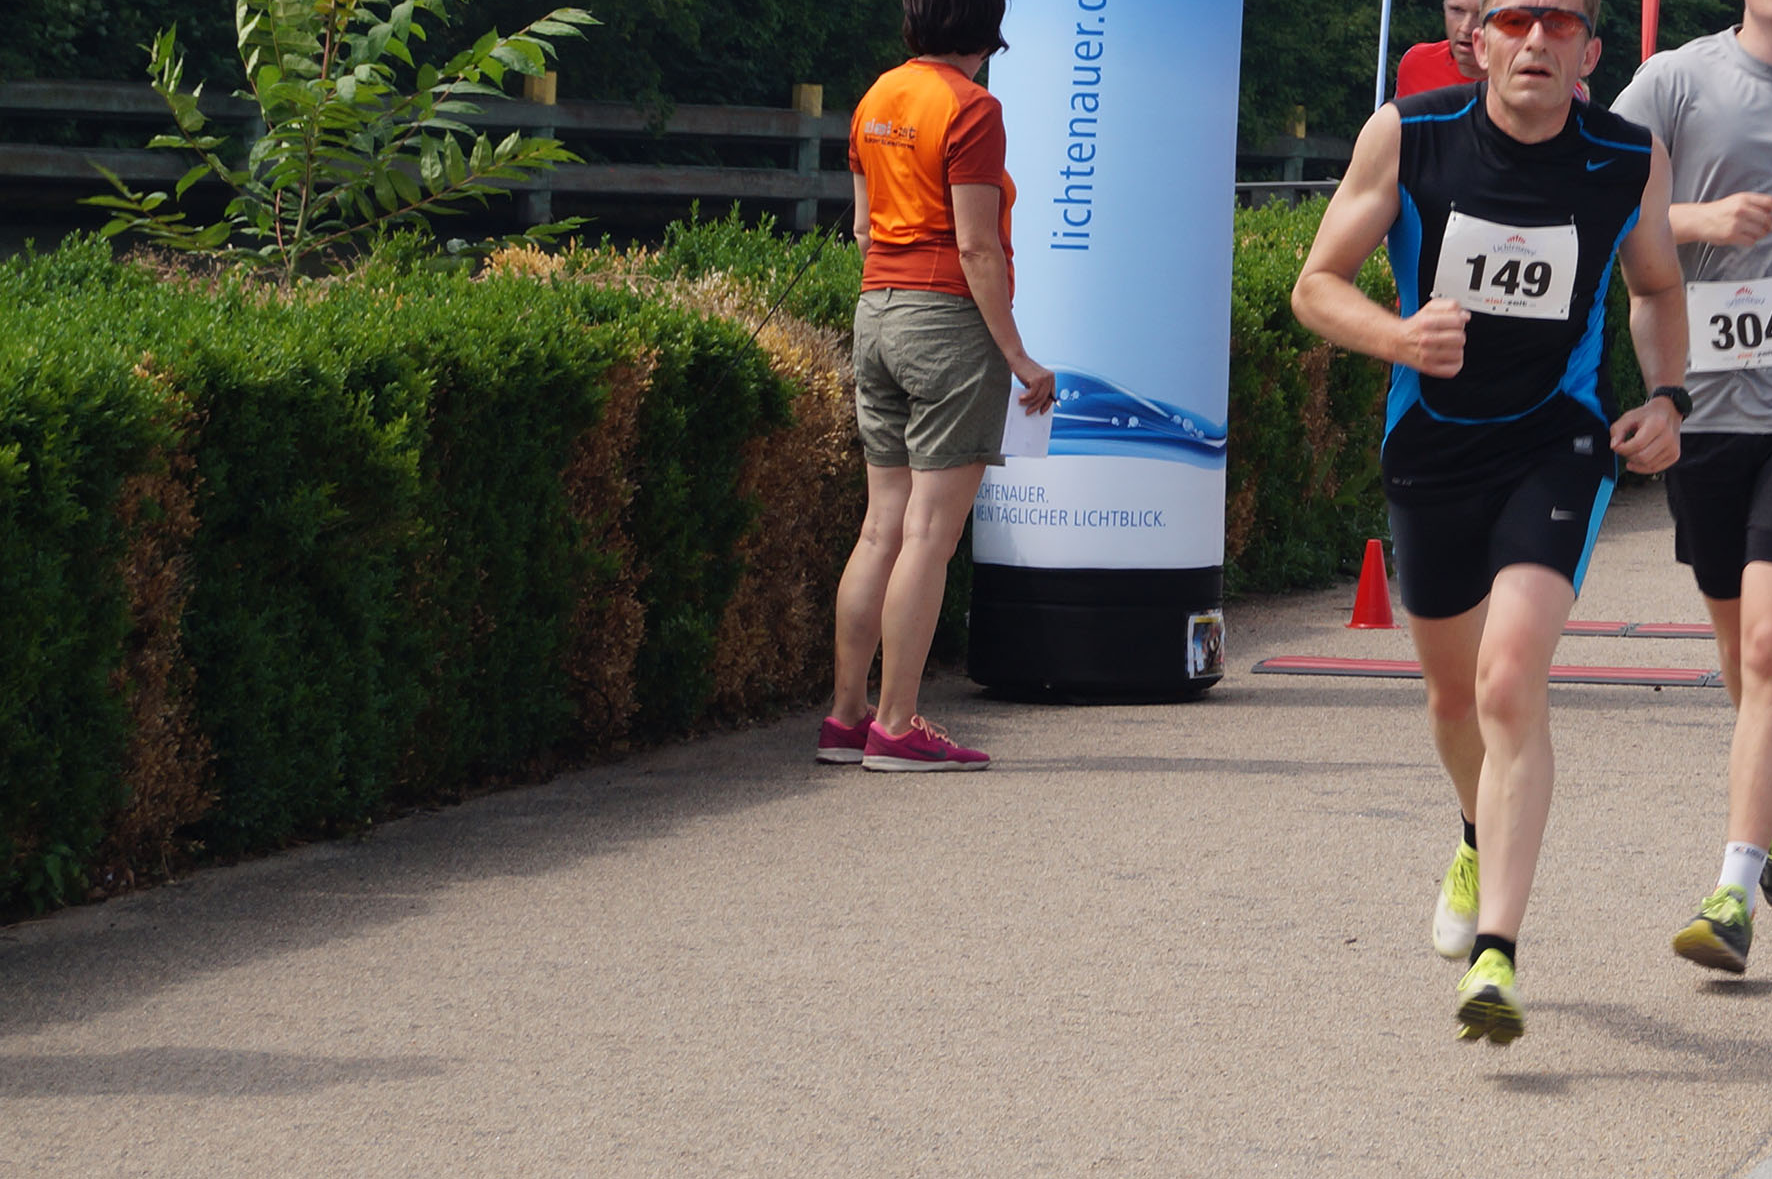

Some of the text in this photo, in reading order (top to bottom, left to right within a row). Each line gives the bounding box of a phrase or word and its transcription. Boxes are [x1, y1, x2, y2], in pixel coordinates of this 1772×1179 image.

[1466, 254, 1552, 297] 149
[997, 504, 1068, 526] TÄGLICHER
[1074, 509, 1167, 528] LICHTBLICK.
